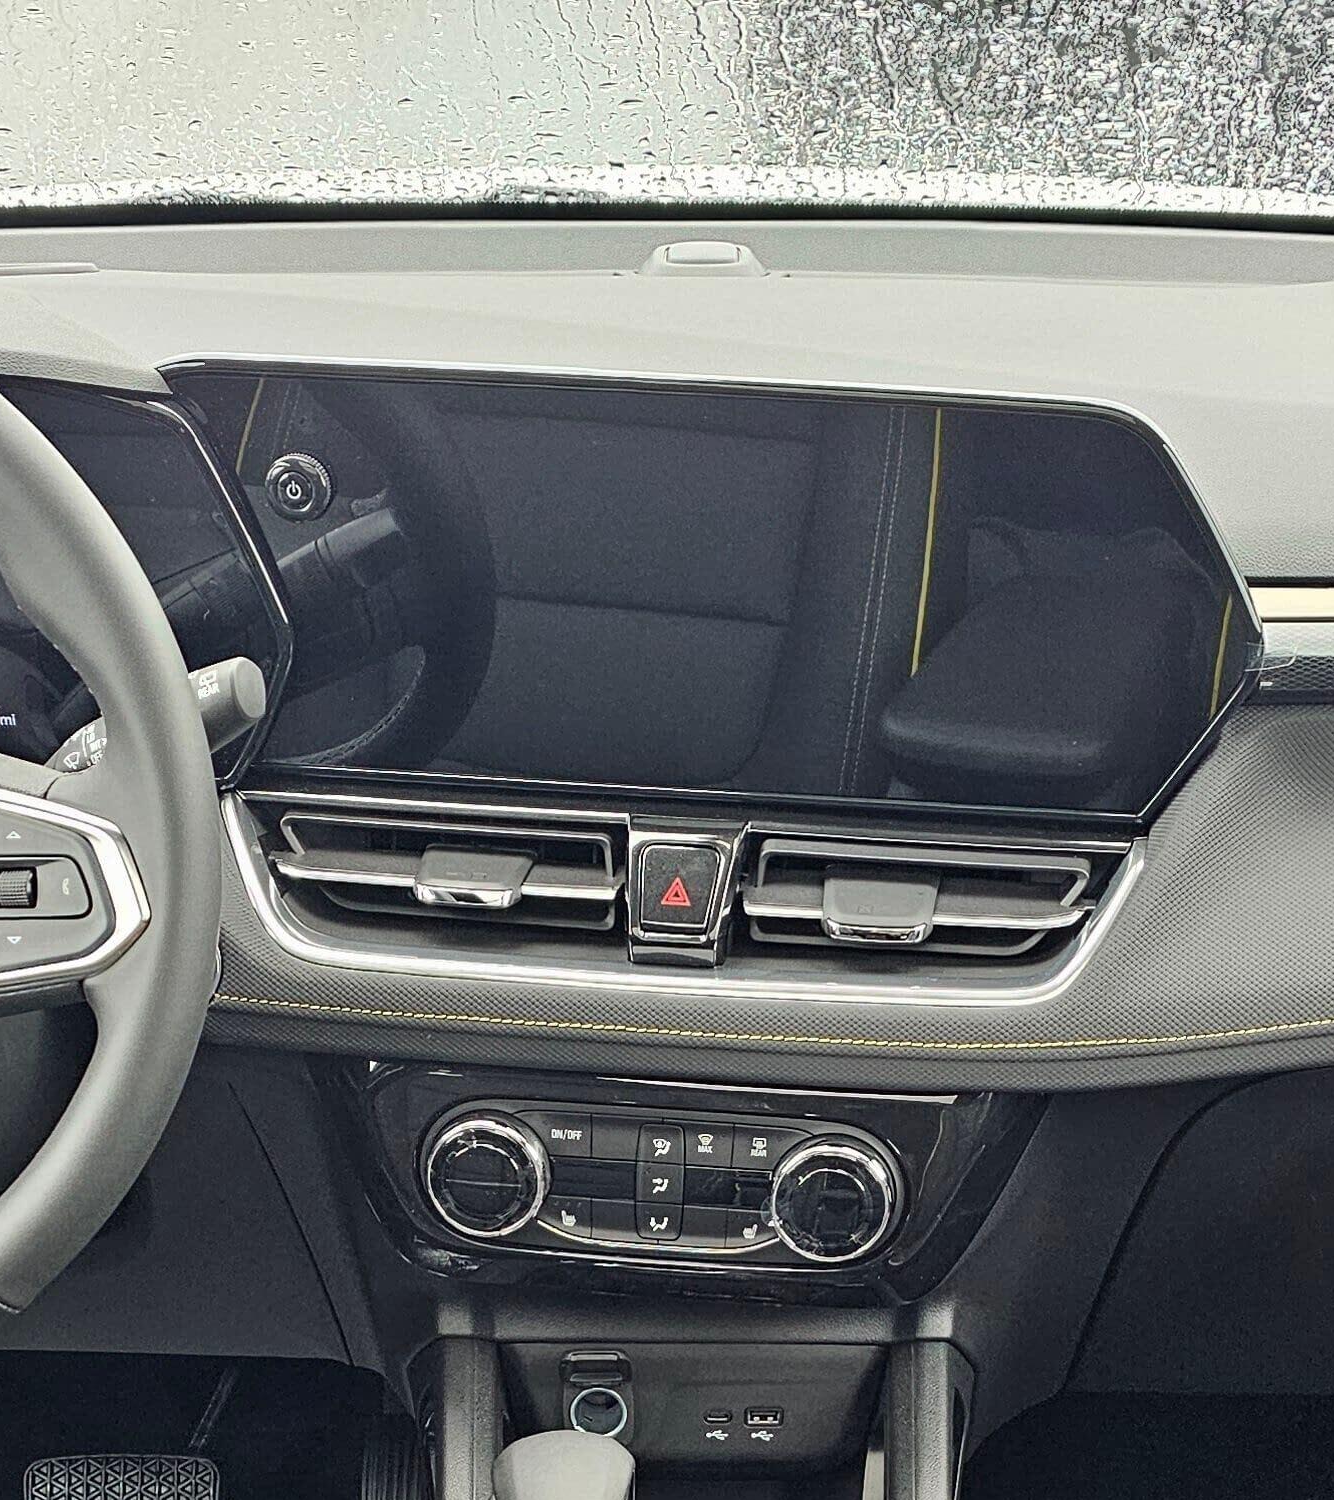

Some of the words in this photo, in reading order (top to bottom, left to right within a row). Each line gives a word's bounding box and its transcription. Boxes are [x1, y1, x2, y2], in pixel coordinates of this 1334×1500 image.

[198, 684, 220, 700] REAR
[551, 1128, 583, 1141] ON/OFF
[697, 1145, 713, 1154] MAX
[750, 1149, 767, 1158] REAR
